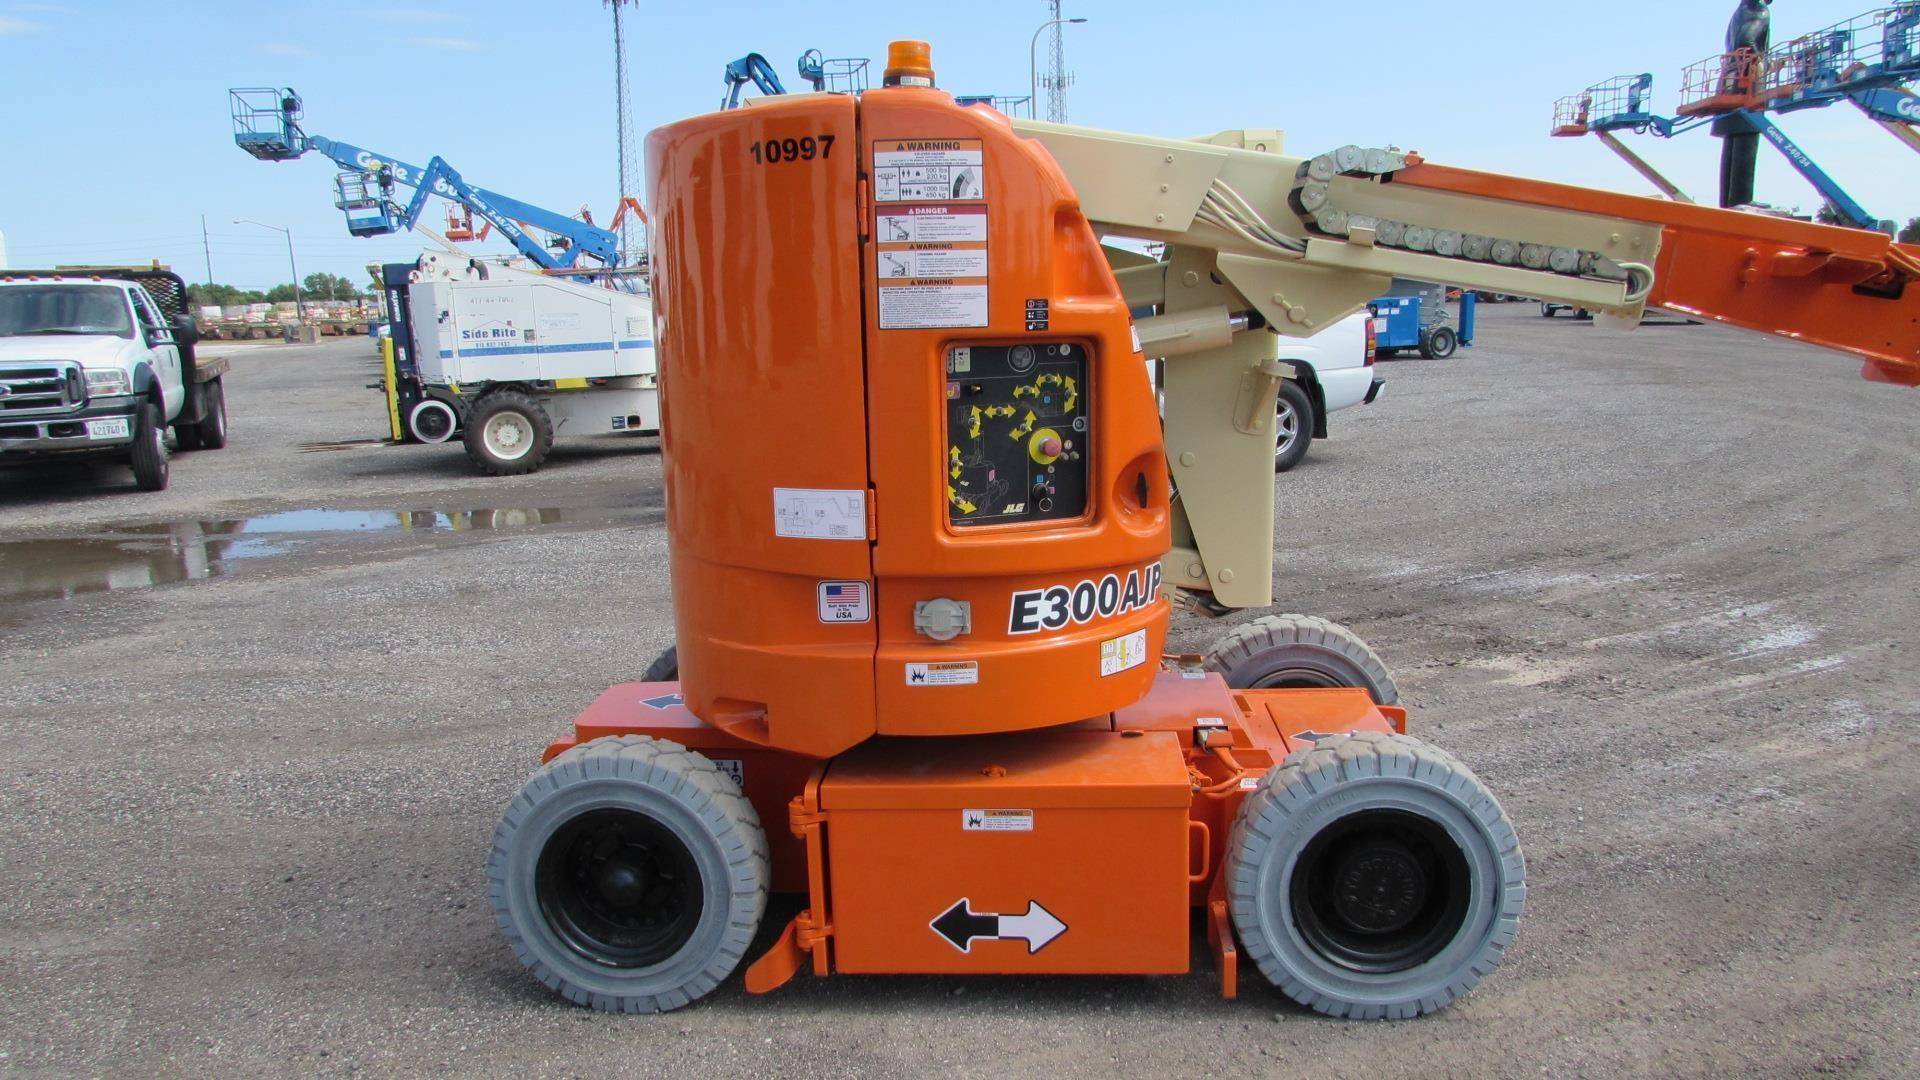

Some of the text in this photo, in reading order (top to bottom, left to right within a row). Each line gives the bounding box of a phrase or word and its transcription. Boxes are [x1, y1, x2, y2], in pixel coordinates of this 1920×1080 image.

[750, 135, 836, 165] 10997
[907, 142, 961, 151] WARNING
[915, 207, 948, 215] DANGER
[462, 328, 516, 339] Side Rite
[1002, 502, 1026, 514] JLG
[1008, 561, 1162, 635] E300AJP
[836, 611, 852, 619] USA
